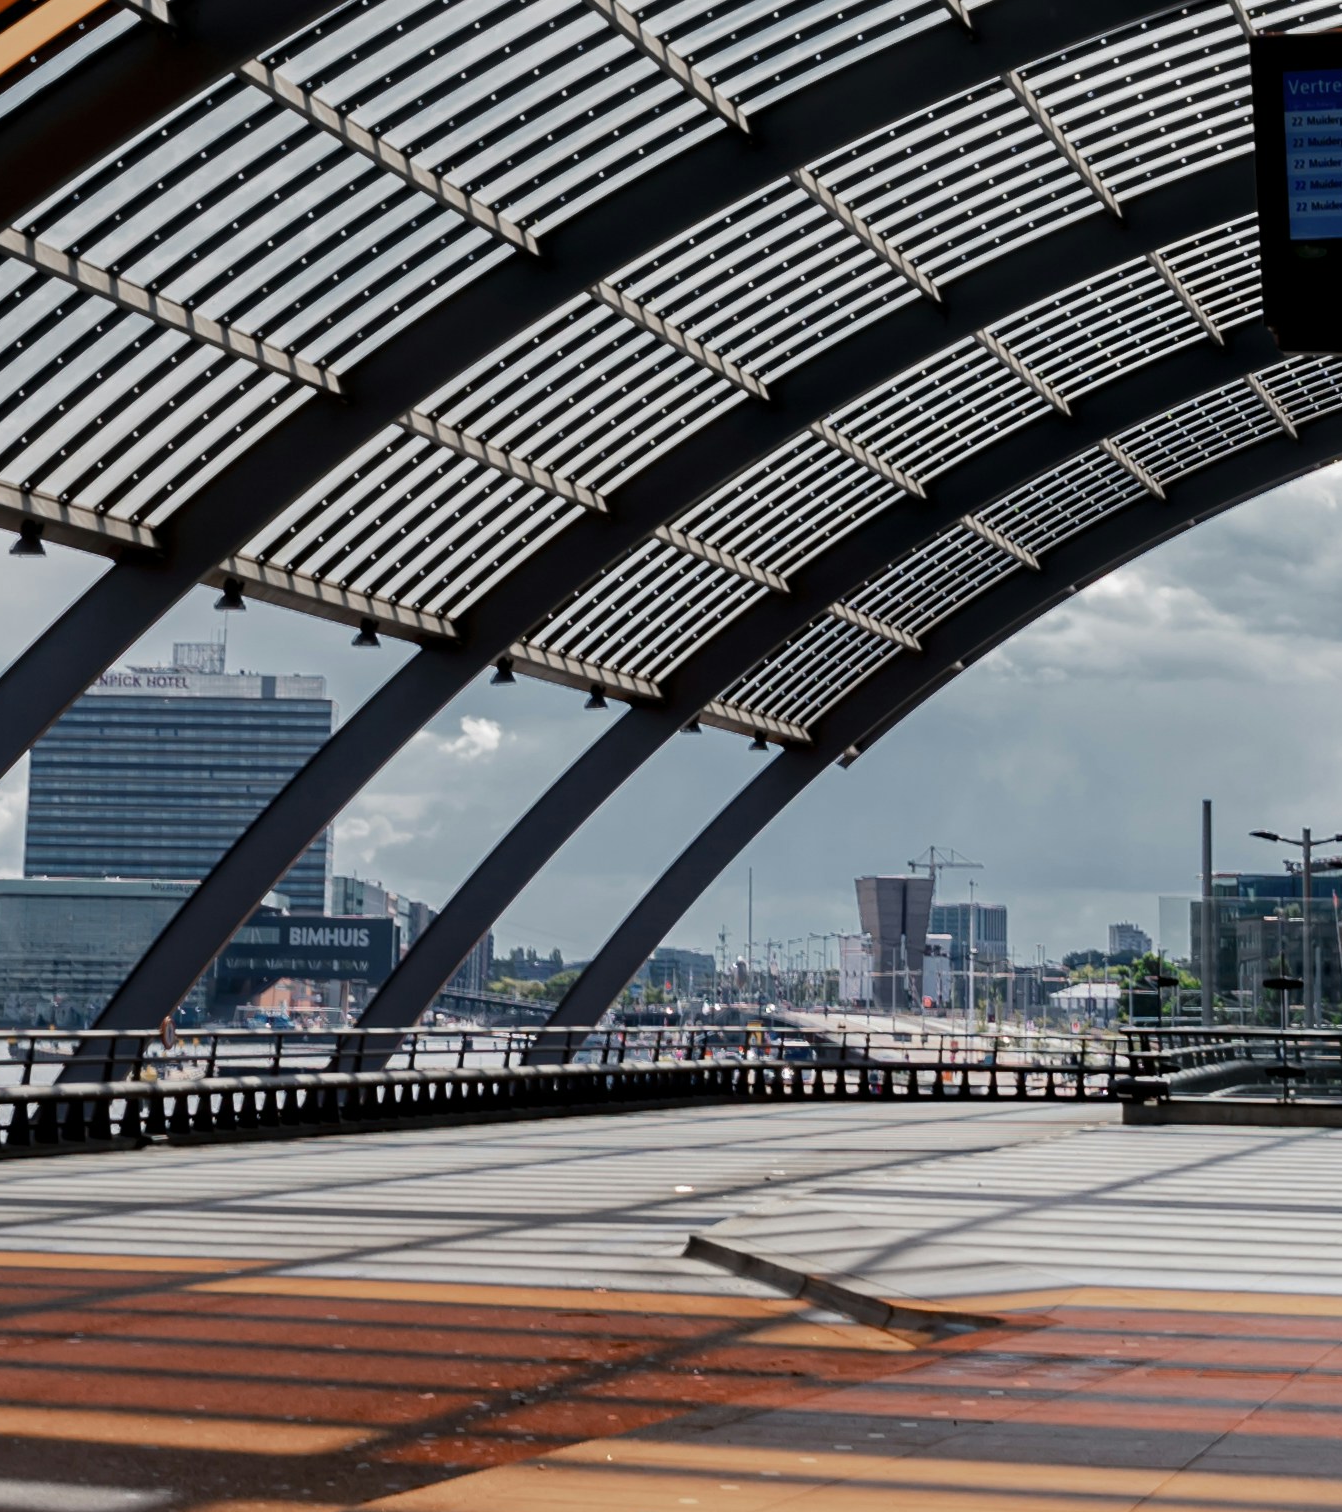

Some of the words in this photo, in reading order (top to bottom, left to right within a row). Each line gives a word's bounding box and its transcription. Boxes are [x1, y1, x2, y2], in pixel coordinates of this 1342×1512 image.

[1291, 116, 1303, 127] 22
[1292, 137, 1304, 148] 22
[1294, 159, 1305, 169] 22
[1295, 180, 1307, 191] 22
[1296, 202, 1308, 212] 22
[95, 673, 142, 688] NPICK
[147, 675, 190, 689] HOTEL
[289, 927, 370, 947] BIMHUIS
